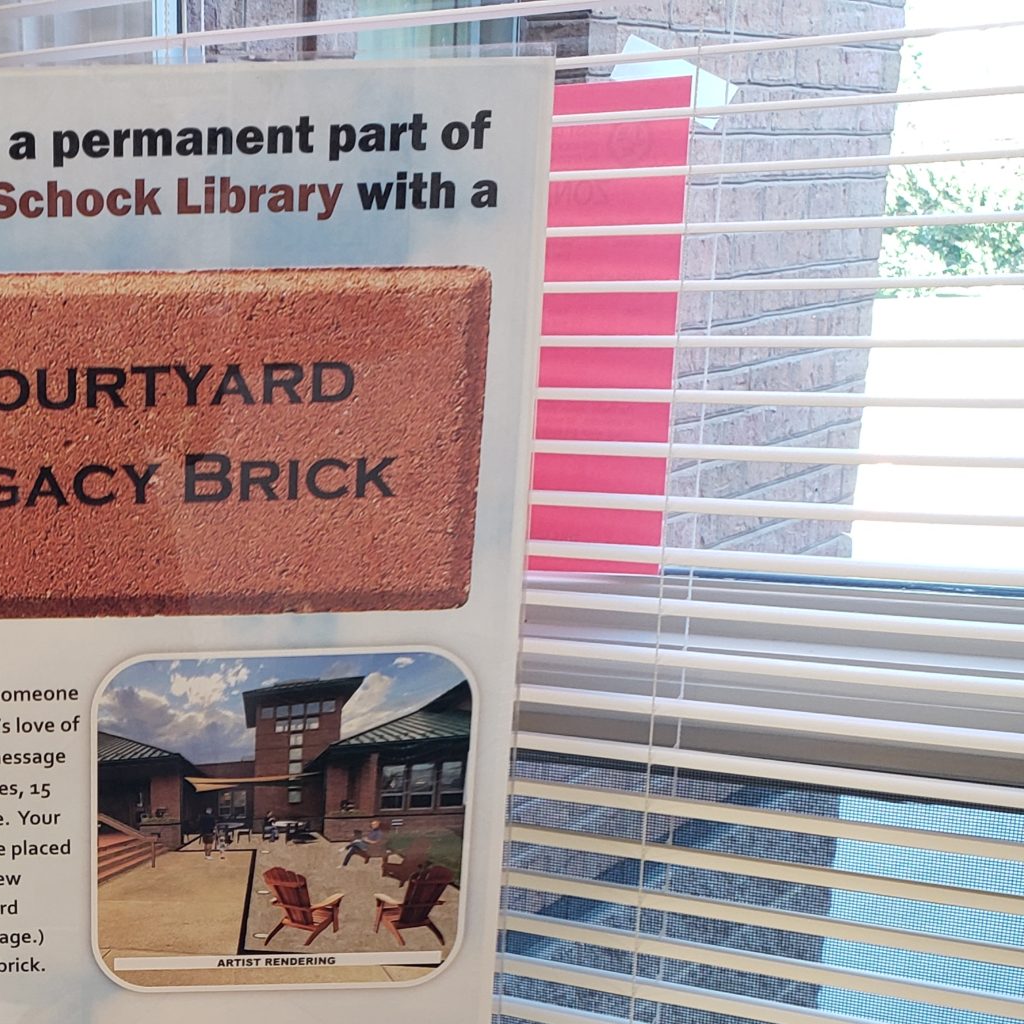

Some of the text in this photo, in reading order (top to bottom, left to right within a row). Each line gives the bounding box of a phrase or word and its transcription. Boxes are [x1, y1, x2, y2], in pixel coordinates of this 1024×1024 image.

[8, 131, 36, 160] a
[52, 115, 314, 166] permanent
[328, 113, 427, 160] part
[440, 109, 492, 150] of
[177, 175, 343, 219] Library
[356, 170, 456, 210] with
[470, 179, 498, 208] a
[16, 716, 54, 733] love
[60, 714, 80, 732] of
[29, 783, 50, 798] 15
[17, 810, 61, 825] Your
[11, 838, 70, 860] placed
[216, 955, 336, 968] ARTIST RENDERING
